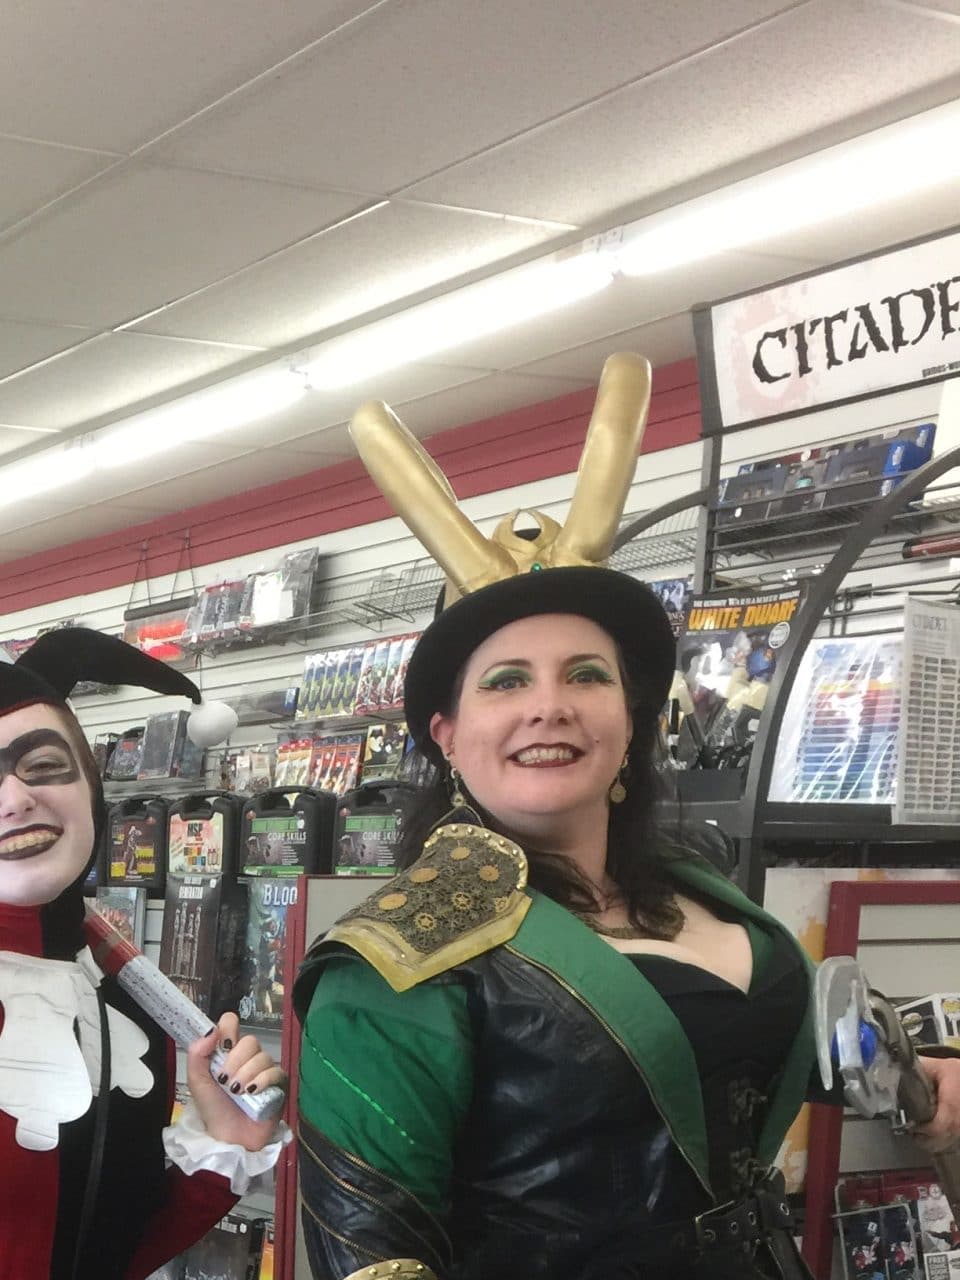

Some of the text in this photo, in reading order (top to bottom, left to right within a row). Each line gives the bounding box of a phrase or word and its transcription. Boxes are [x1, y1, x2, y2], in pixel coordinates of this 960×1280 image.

[688, 606, 742, 630] WHITE
[742, 598, 799, 627] DWARF
[287, 831, 307, 841] SKILLS
